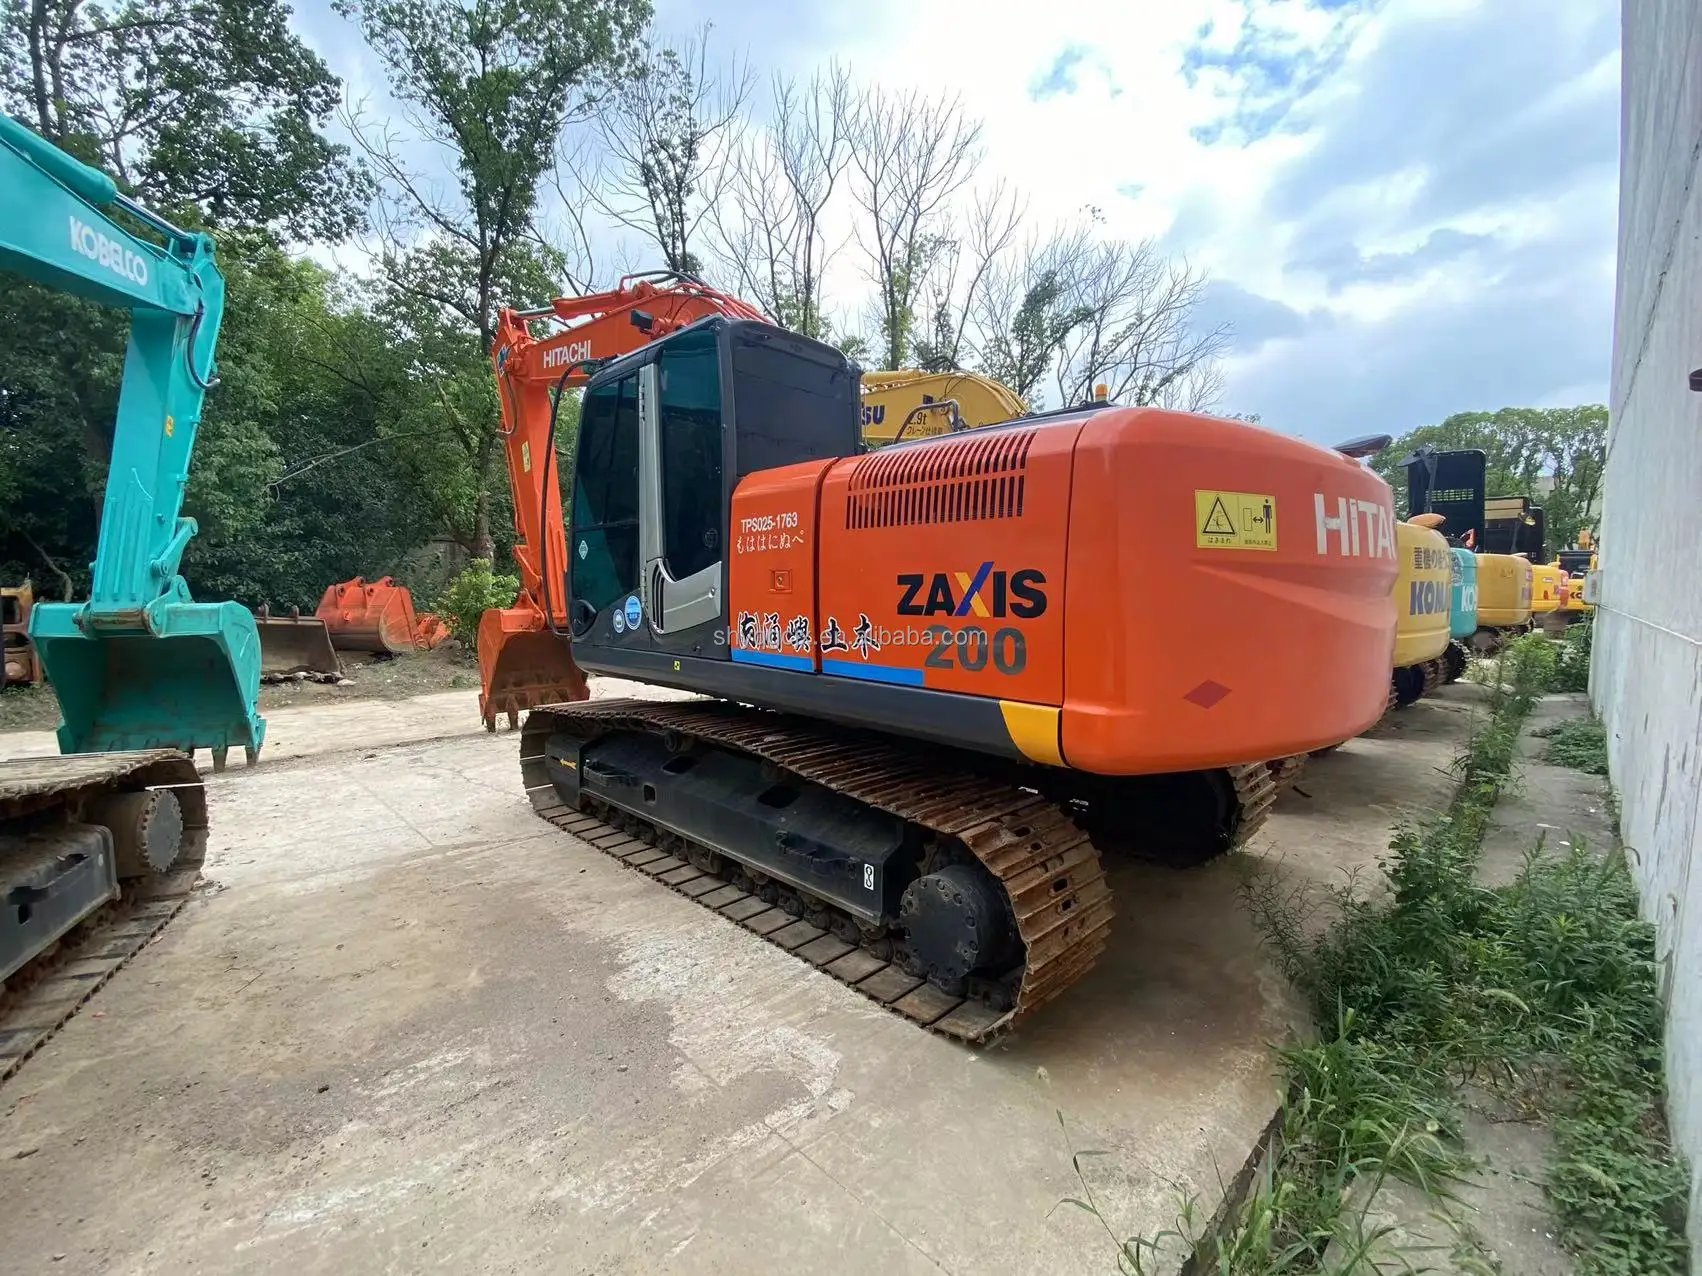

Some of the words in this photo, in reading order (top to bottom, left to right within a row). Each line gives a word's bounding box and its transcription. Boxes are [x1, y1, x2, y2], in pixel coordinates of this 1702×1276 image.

[69, 216, 148, 286] KOBELCO
[543, 339, 591, 369] HITACHI
[862, 402, 885, 425] SU
[740, 512, 798, 533] TPS025-1763
[896, 561, 1048, 619] ZAXIS
[924, 624, 1027, 676] 200
